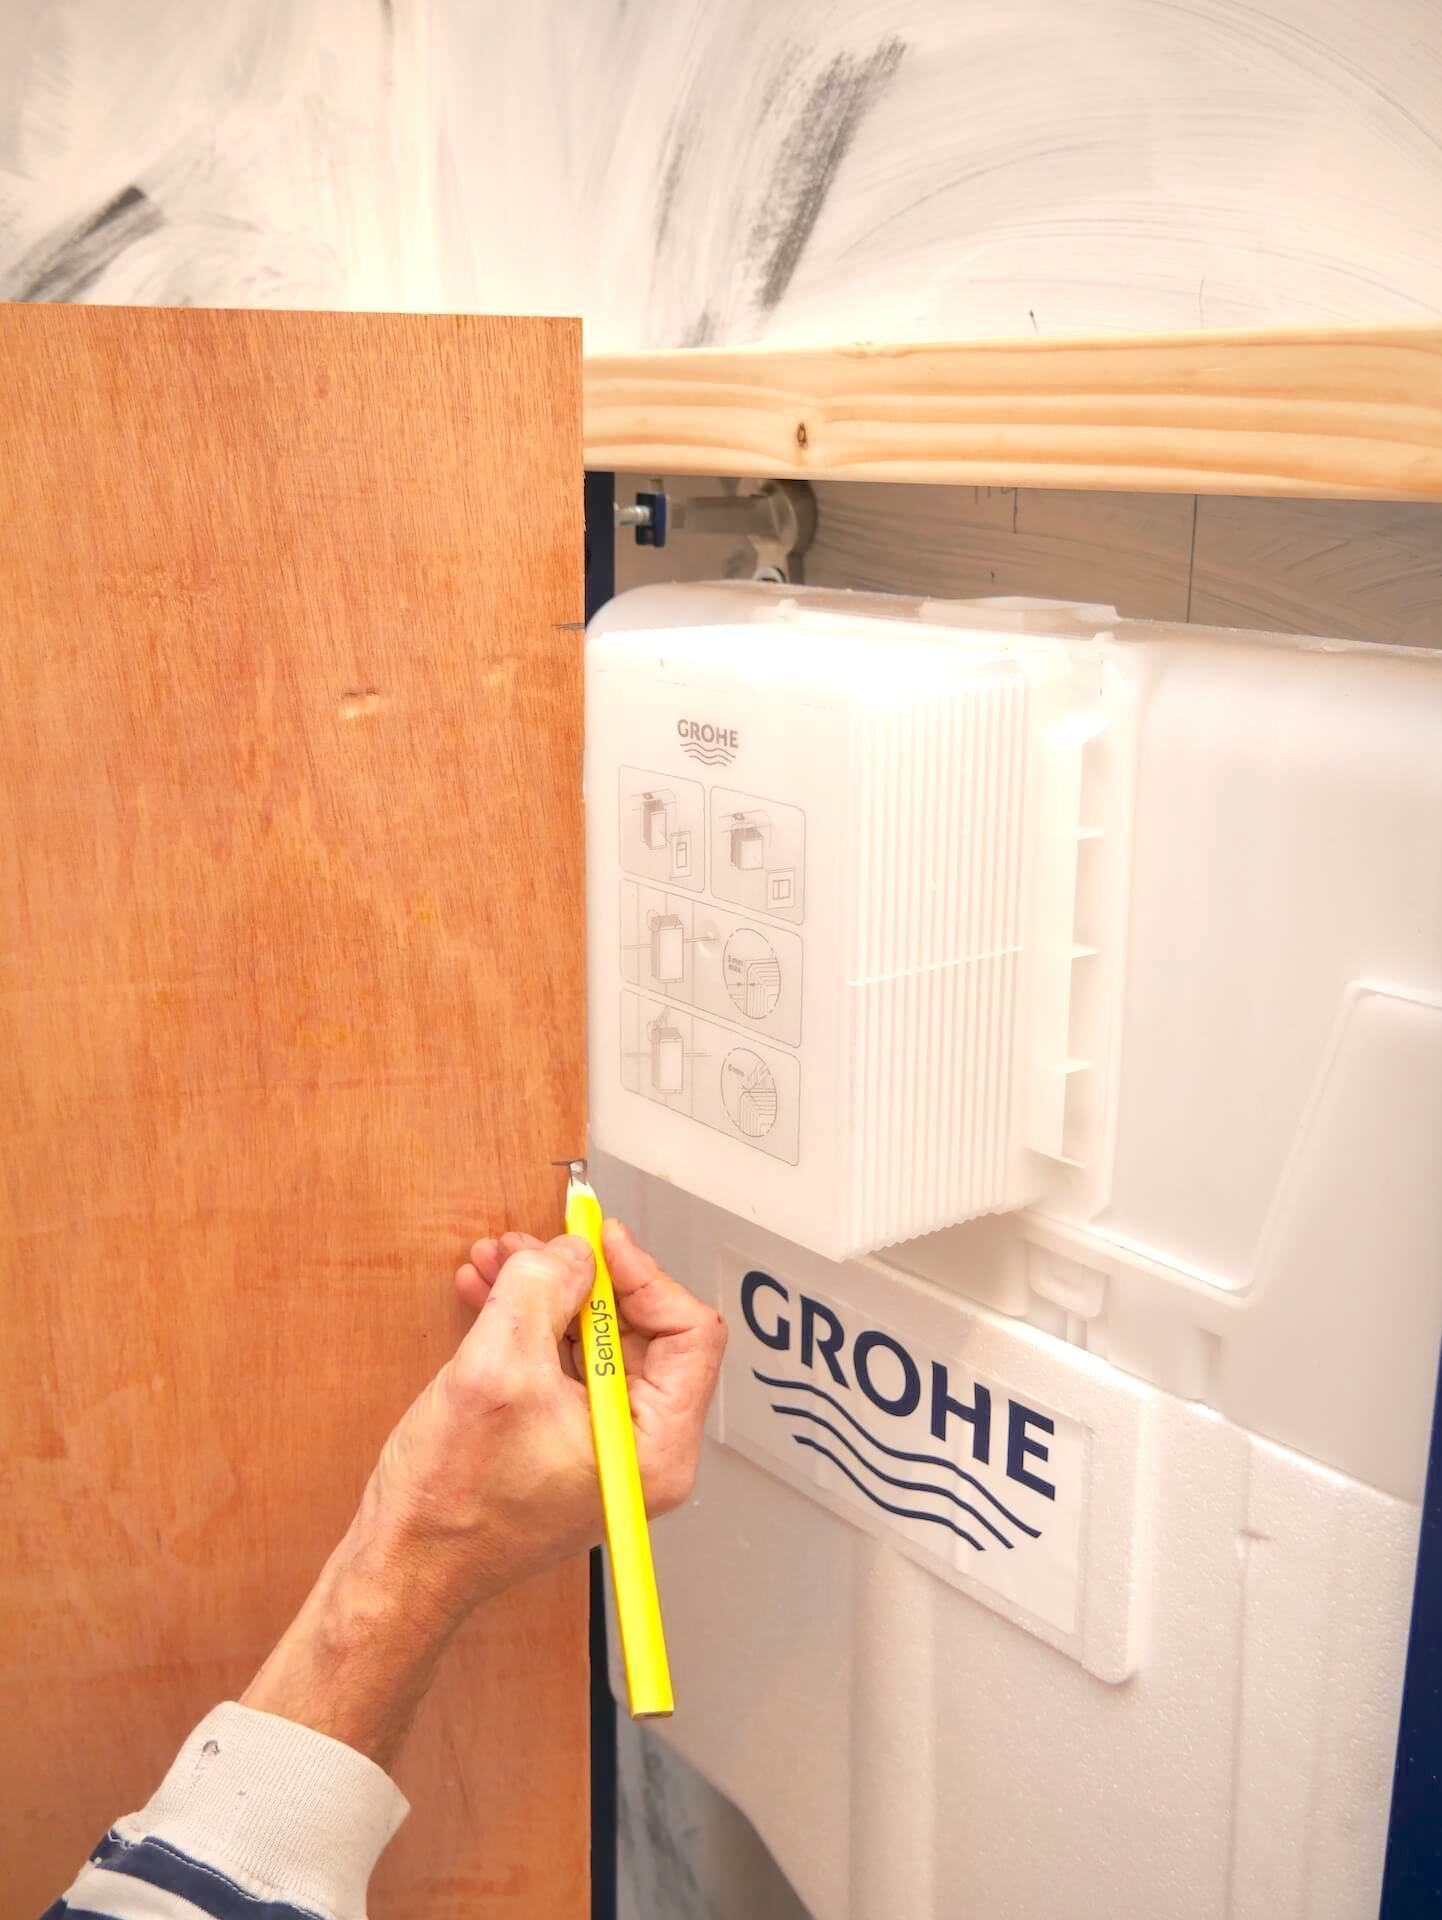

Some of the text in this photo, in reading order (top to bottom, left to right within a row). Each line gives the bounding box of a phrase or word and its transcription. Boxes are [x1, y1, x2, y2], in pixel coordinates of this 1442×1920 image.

[677, 719, 739, 748] GROHE
[591, 1300, 616, 1376] Sencys
[741, 1270, 1056, 1501] GROHE
